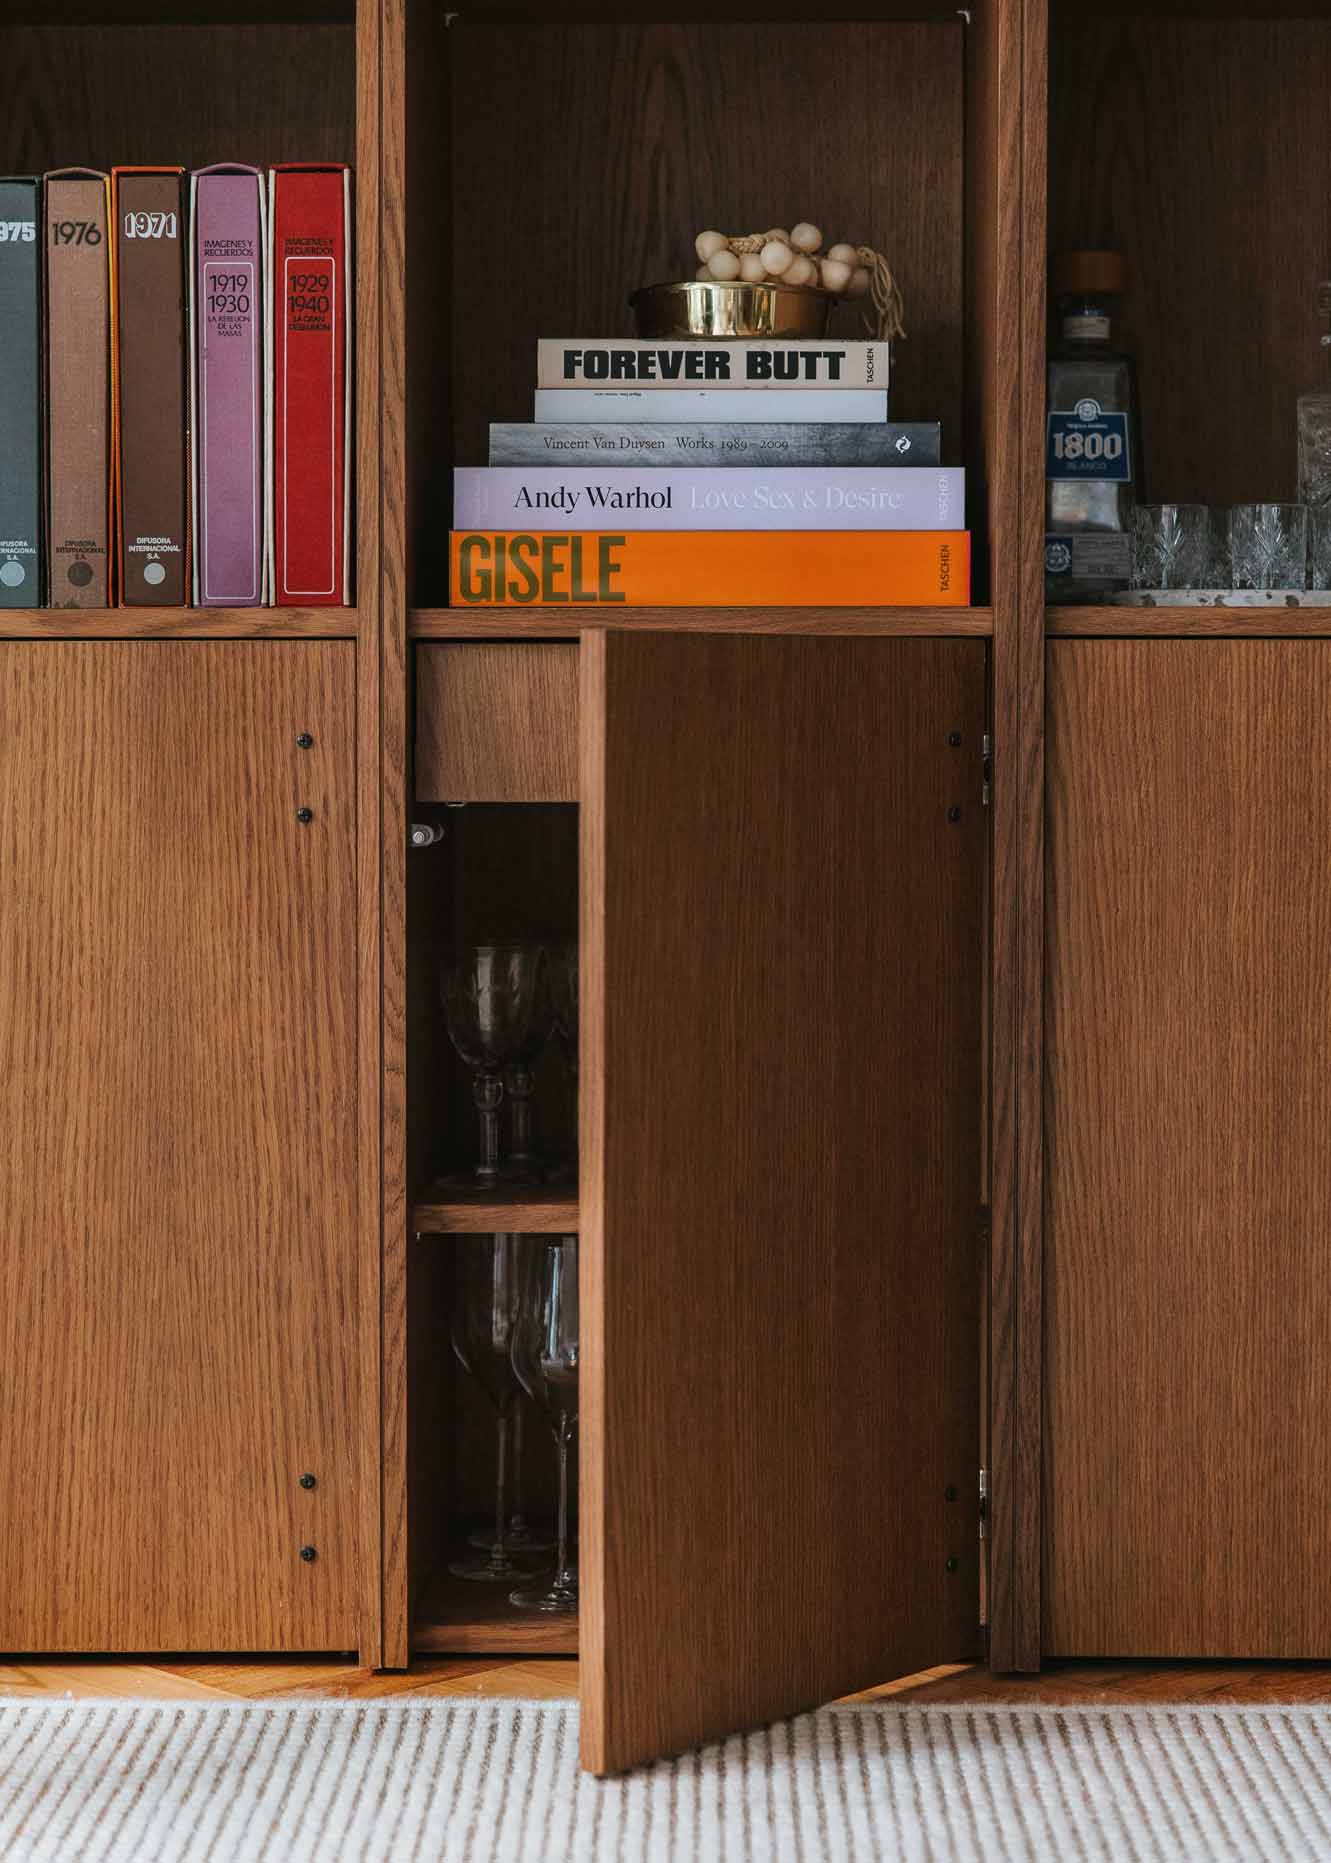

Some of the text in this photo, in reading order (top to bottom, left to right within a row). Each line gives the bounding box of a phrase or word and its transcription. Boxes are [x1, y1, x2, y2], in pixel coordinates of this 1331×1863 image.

[52, 221, 102, 246] 1976
[124, 211, 177, 239] 1971
[204, 239, 253, 248] IMAGENES Y
[204, 248, 254, 256] RECUERDOS
[209, 274, 248, 293] 1919
[289, 274, 329, 293] 1929
[207, 294, 250, 313] 1930
[288, 295, 330, 313] 1940
[563, 350, 846, 380] FOREVER BUTT
[866, 347, 874, 384] TASCHEN
[543, 436, 588, 449] Vincent
[592, 436, 616, 449] Van
[619, 436, 665, 452] Duysen
[676, 436, 714, 449] Works
[720, 439, 748, 452] 1989
[760, 440, 789, 450] 2009
[1052, 432, 1122, 460] 1800
[514, 486, 580, 514] Andy
[584, 486, 672, 509] Warhol
[690, 486, 746, 510] Love
[752, 486, 797, 509] Sex
[801, 488, 817, 509] &
[825, 486, 901, 510] Desire
[128, 544, 182, 552] INTERNACIONAL
[136, 536, 172, 545] DIFUSORA
[459, 534, 626, 603] GISELE
[940, 544, 950, 592] TASCHEN
